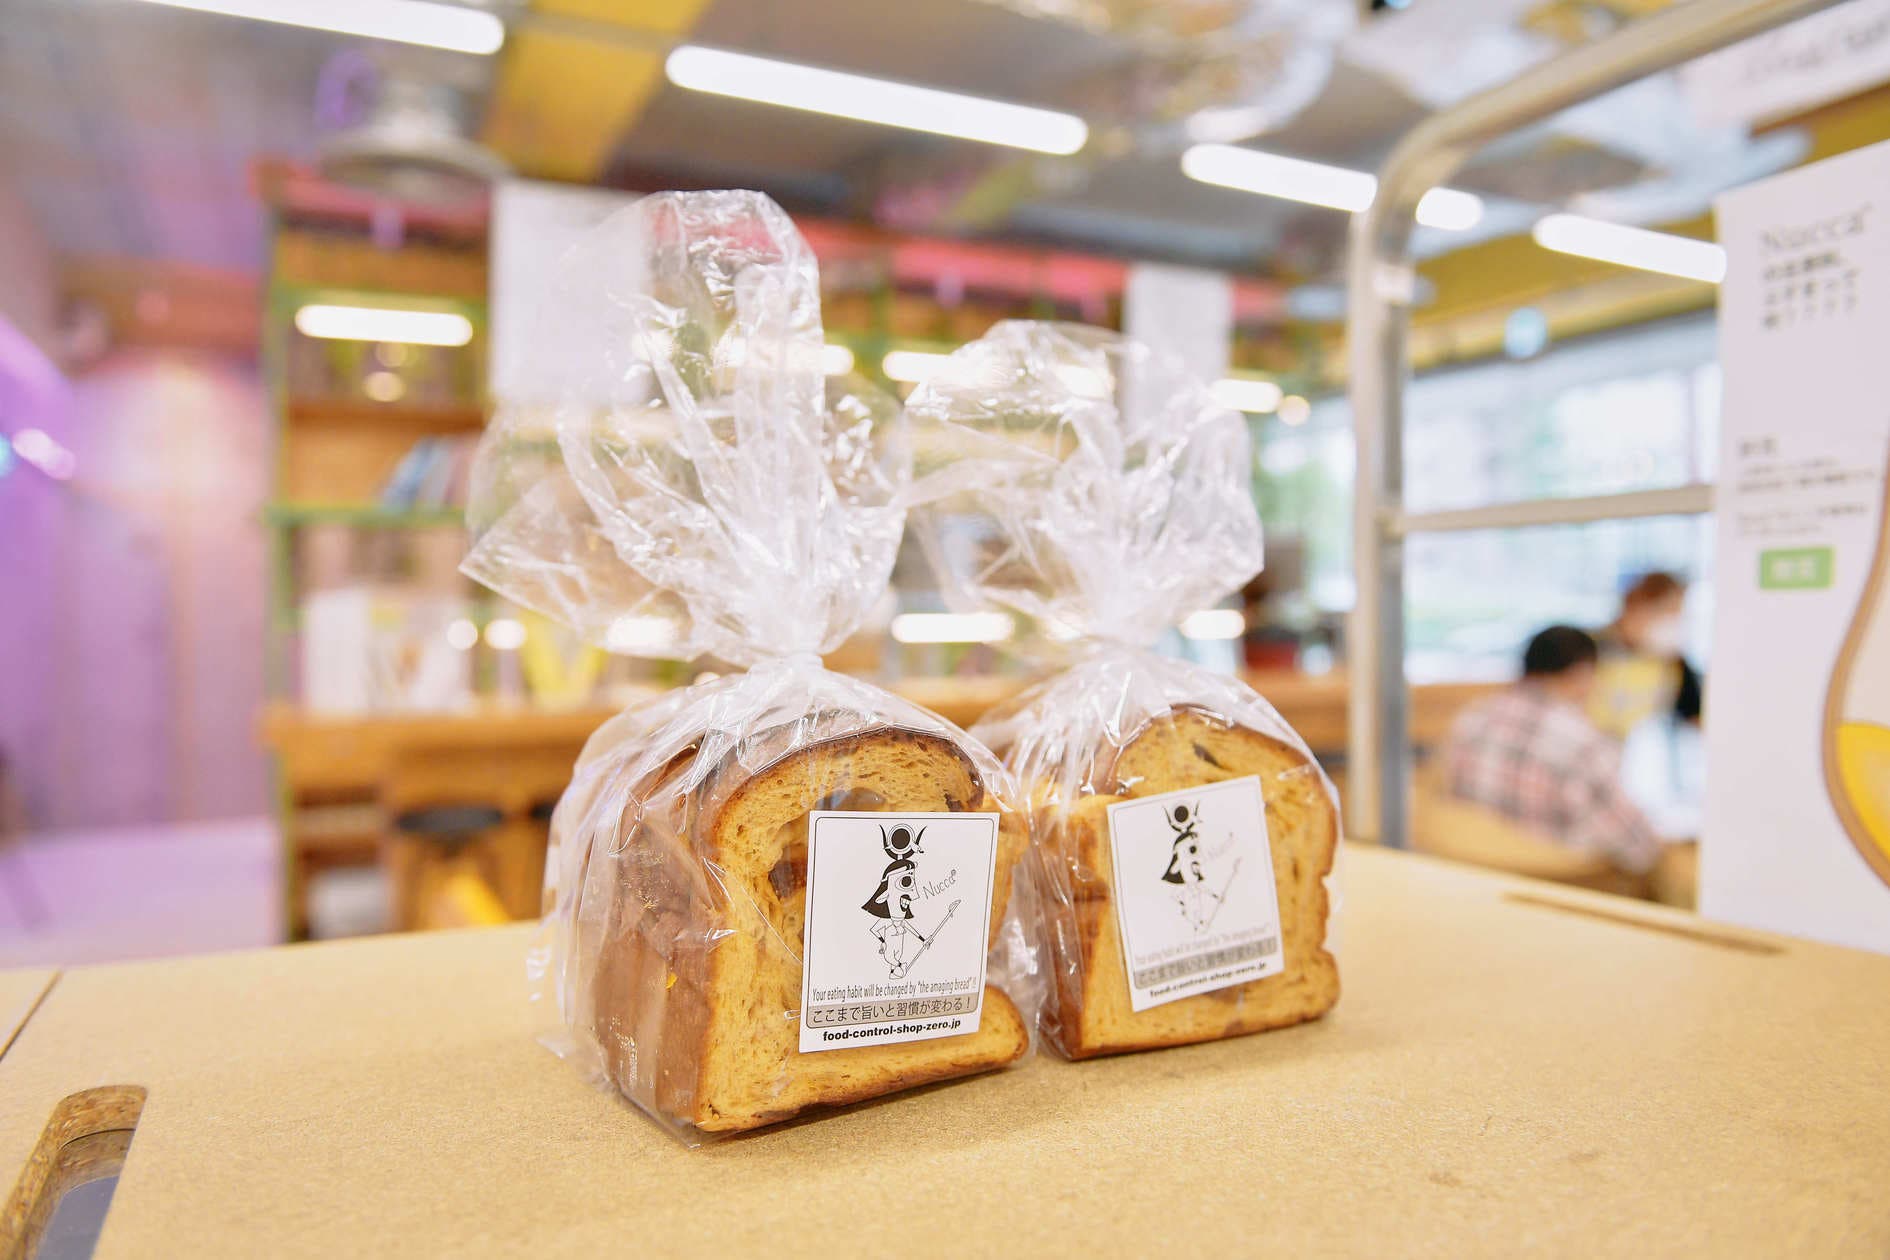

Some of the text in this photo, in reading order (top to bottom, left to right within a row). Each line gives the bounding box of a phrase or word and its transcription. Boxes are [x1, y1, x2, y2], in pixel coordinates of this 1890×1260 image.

[812, 988, 827, 1002] Your
[827, 986, 846, 1002] eating
[847, 983, 863, 999] habit
[864, 983, 875, 997] will
[875, 983, 883, 997] be
[884, 981, 908, 998] changed
[908, 981, 917, 997] by
[823, 1018, 961, 1042] food-control-shop-zero.jp
